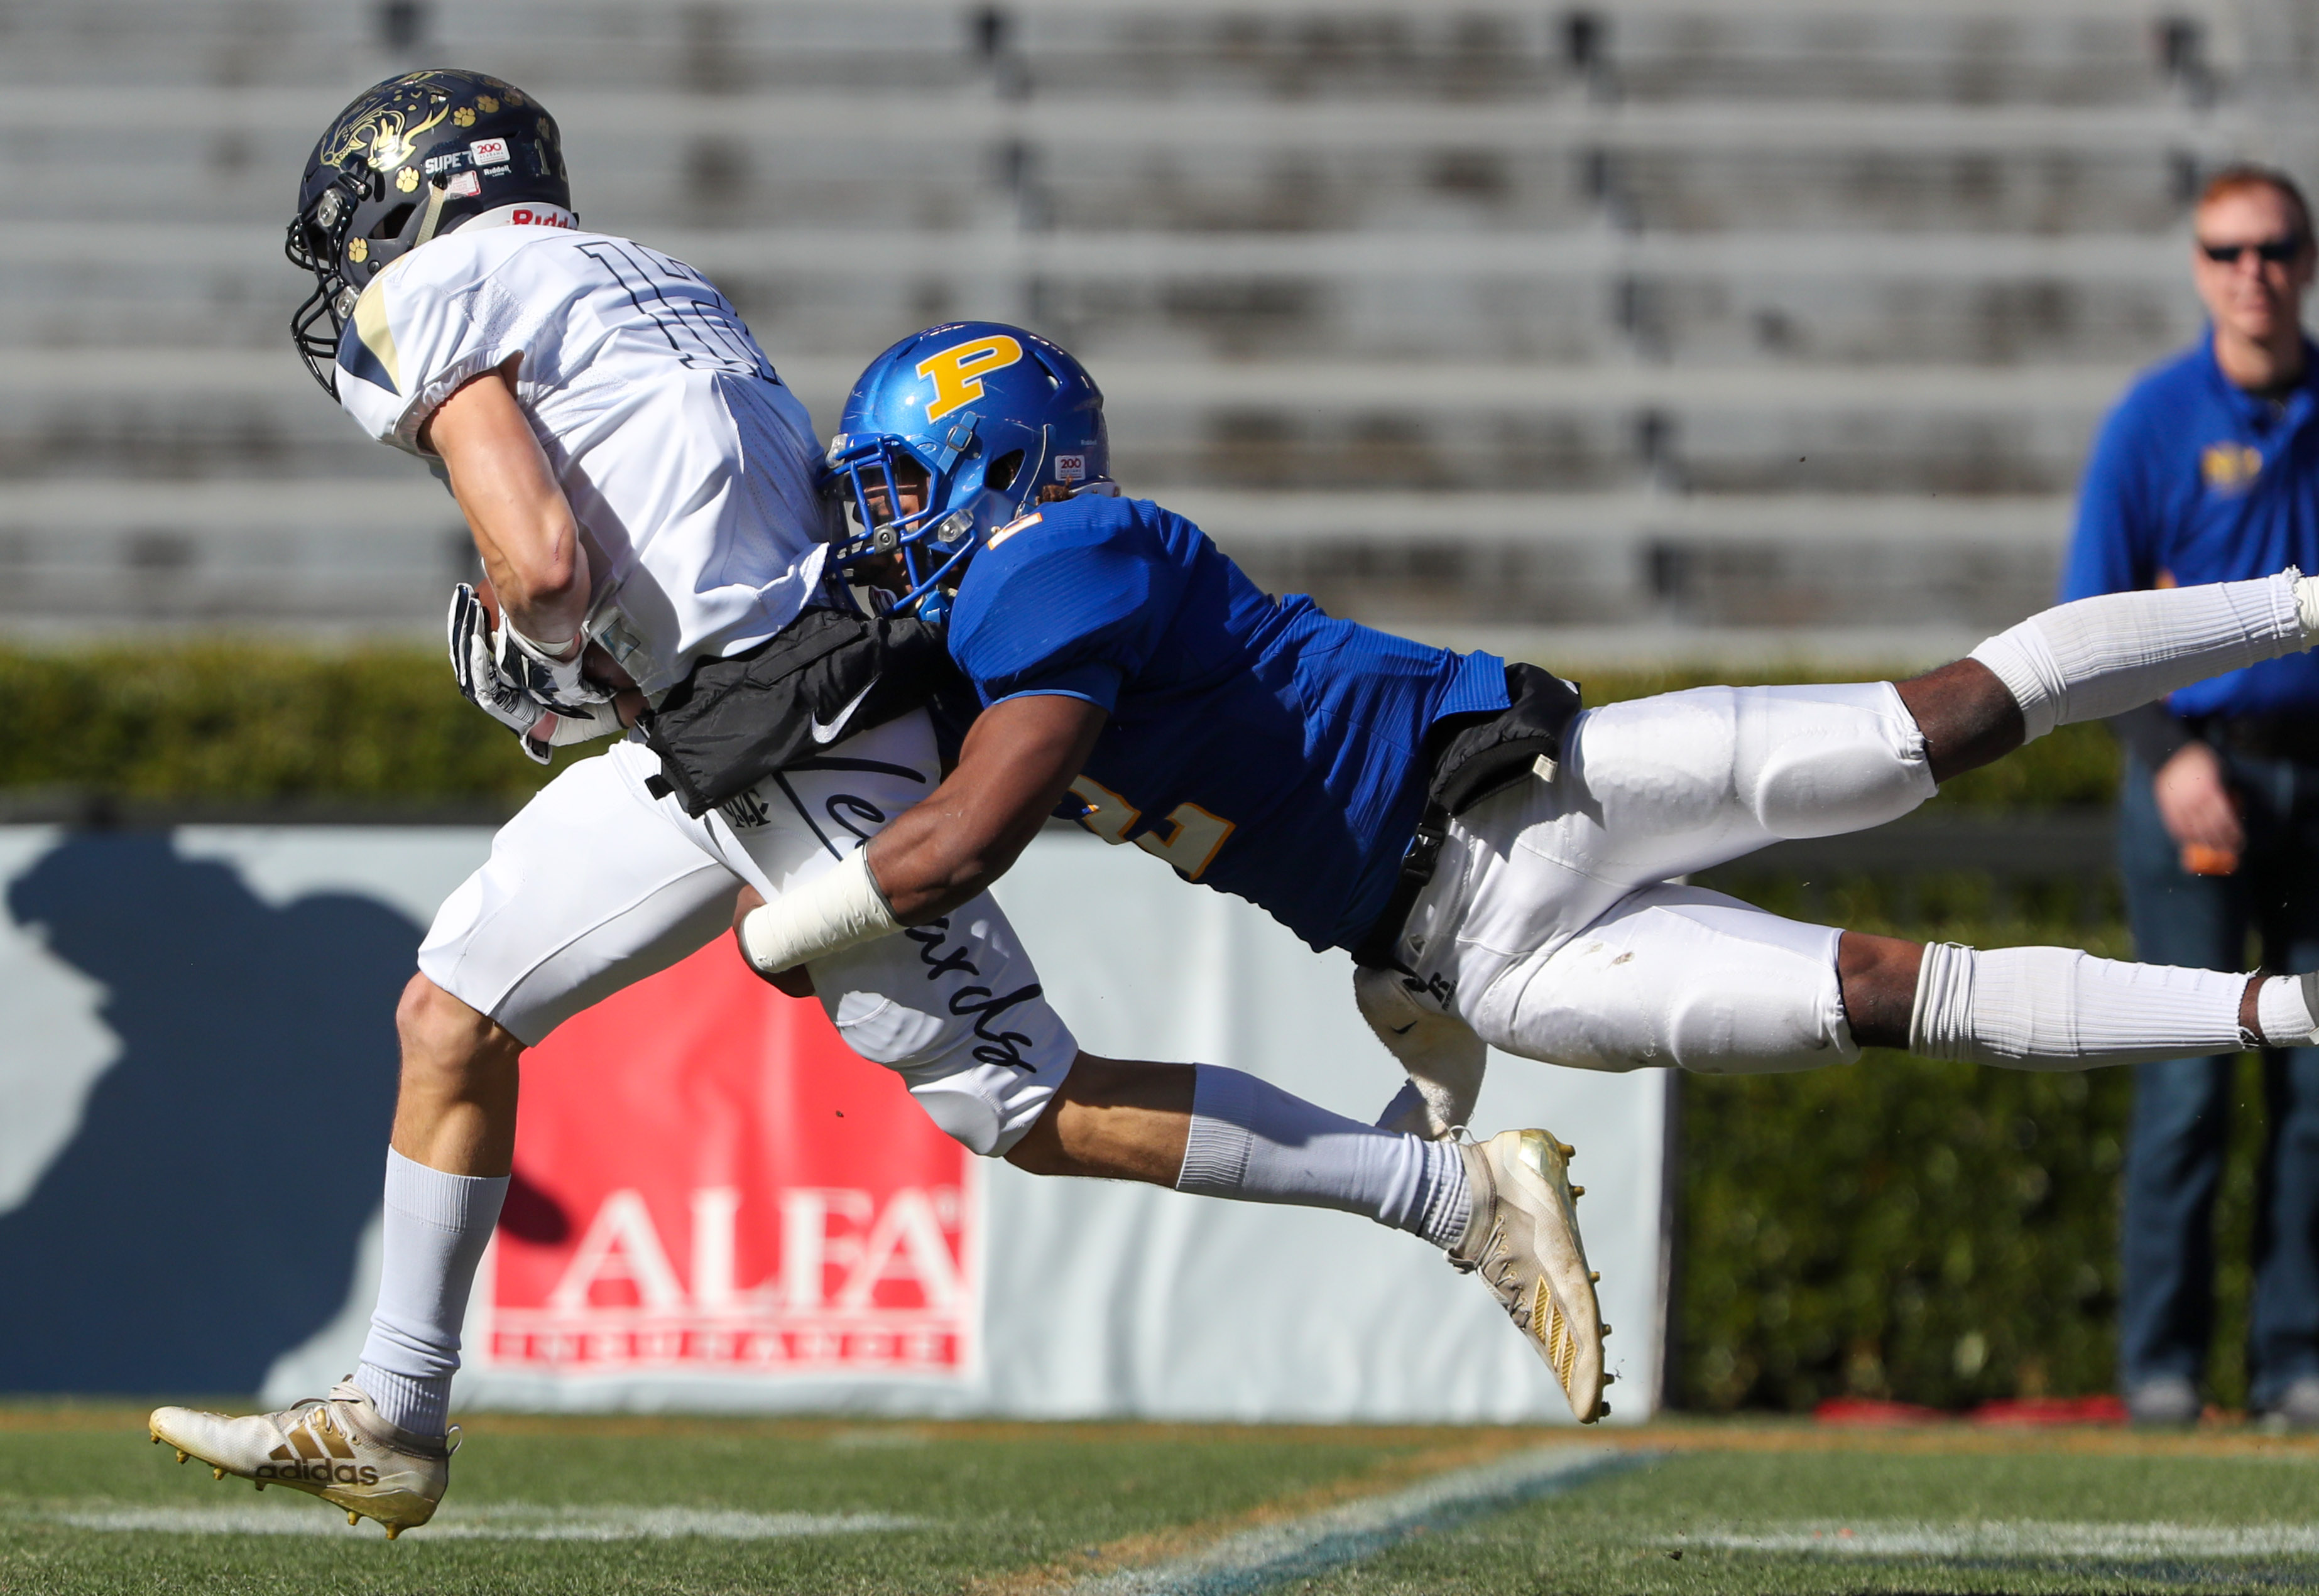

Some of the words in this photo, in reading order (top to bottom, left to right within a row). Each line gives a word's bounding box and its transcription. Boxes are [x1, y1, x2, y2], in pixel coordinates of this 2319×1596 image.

[477, 142, 502, 155] 200
[915, 335, 1023, 425] P
[1061, 458, 1081, 469] 200
[544, 1185, 973, 1319] ALFA
[255, 1458, 379, 1485] adidas
